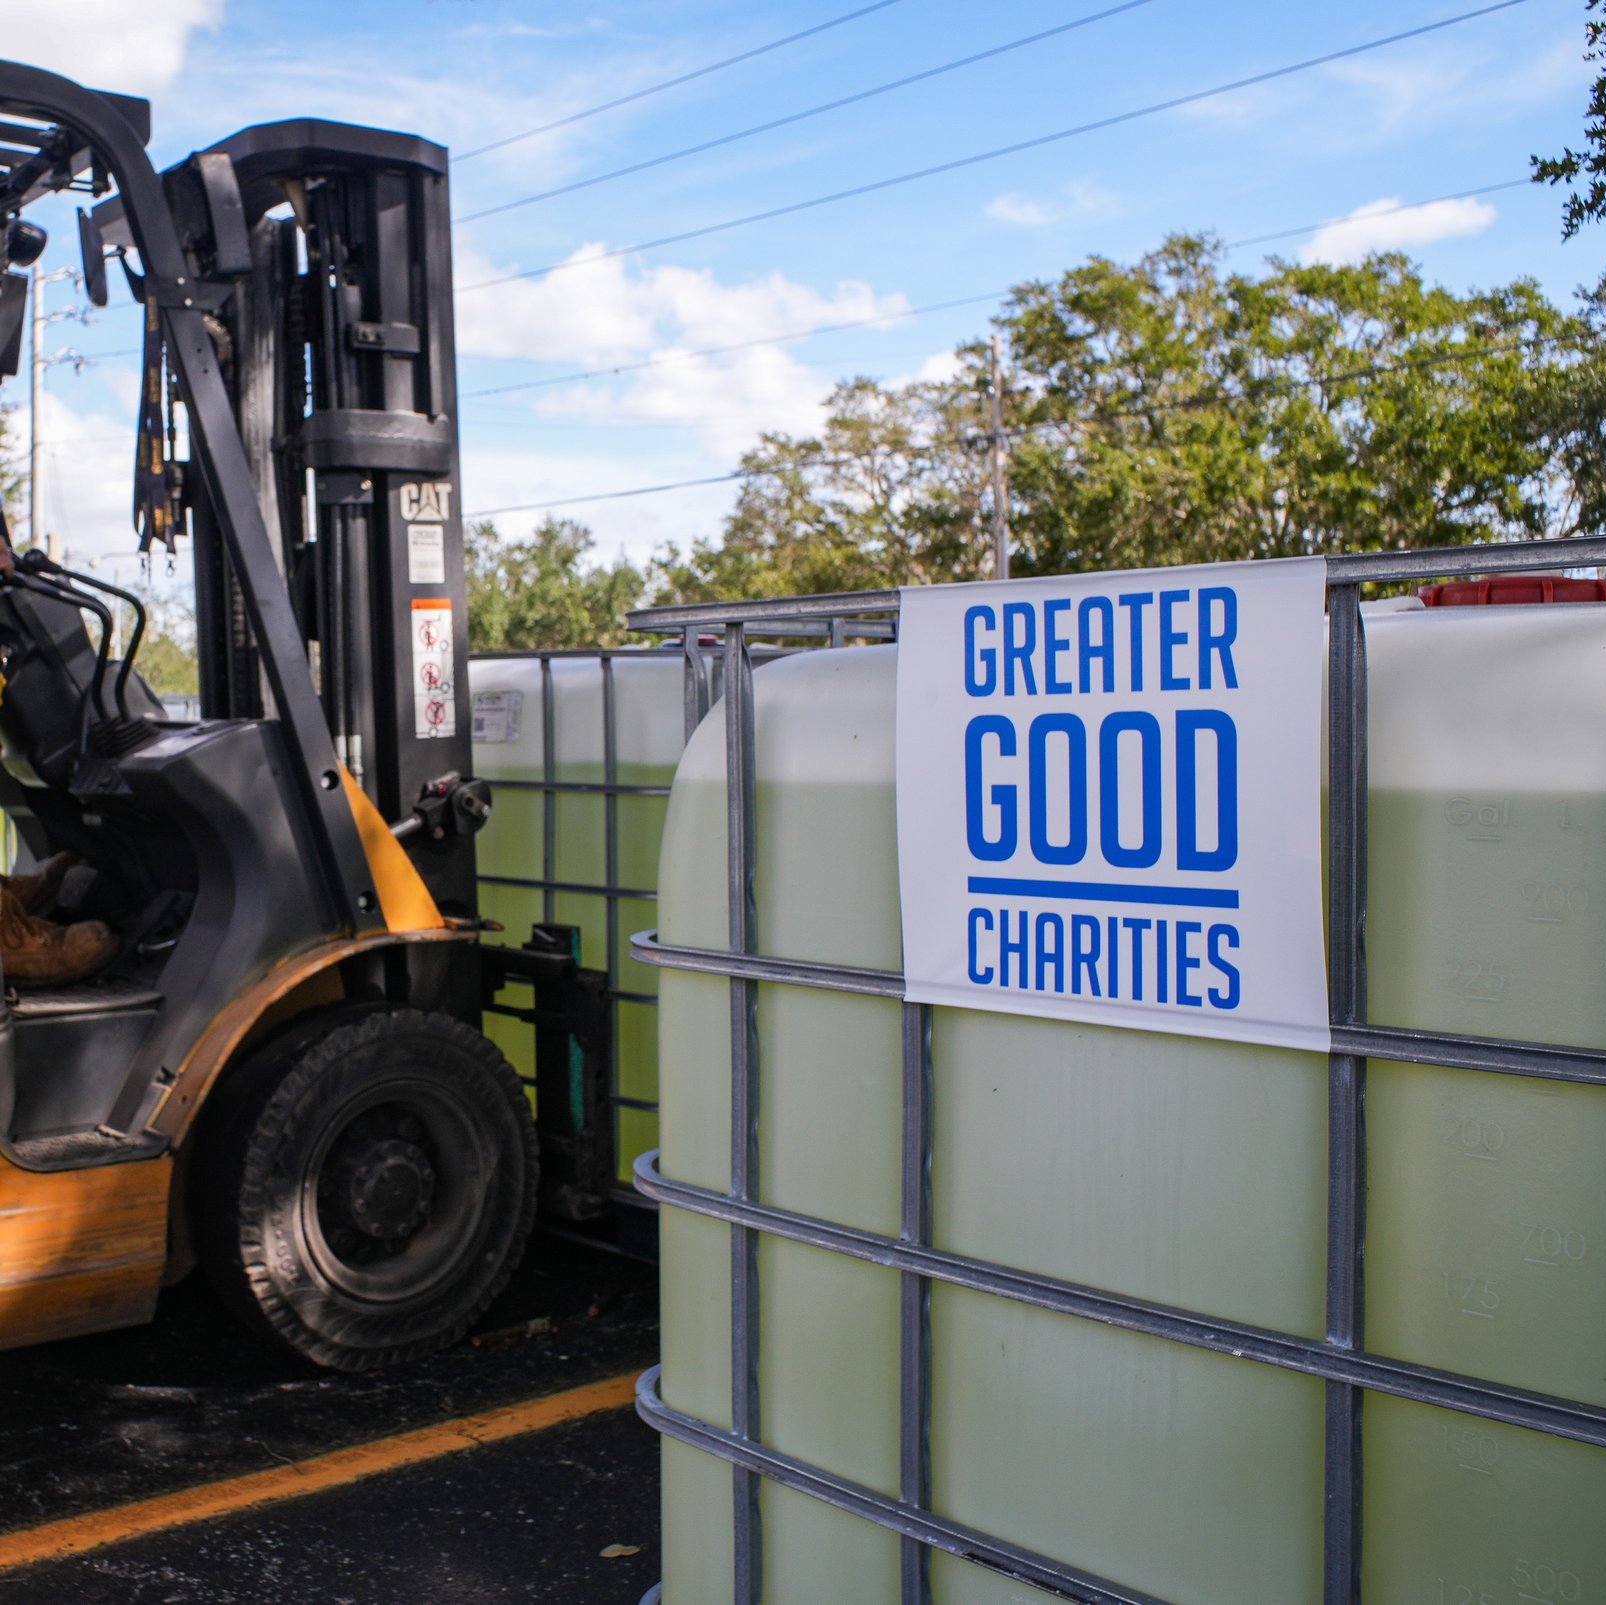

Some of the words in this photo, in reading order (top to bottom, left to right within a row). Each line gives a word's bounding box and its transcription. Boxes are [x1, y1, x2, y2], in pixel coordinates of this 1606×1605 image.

[400, 482, 452, 521] CAT
[964, 586, 1239, 697] GREATER
[965, 709, 1239, 872] GOOD
[967, 907, 1241, 1010] CHARITIES
[1519, 1221, 1588, 1261] 700
[1443, 1271, 1501, 1310] 175
[1442, 1425, 1500, 1466] 150
[1510, 1557, 1582, 1602] 500
